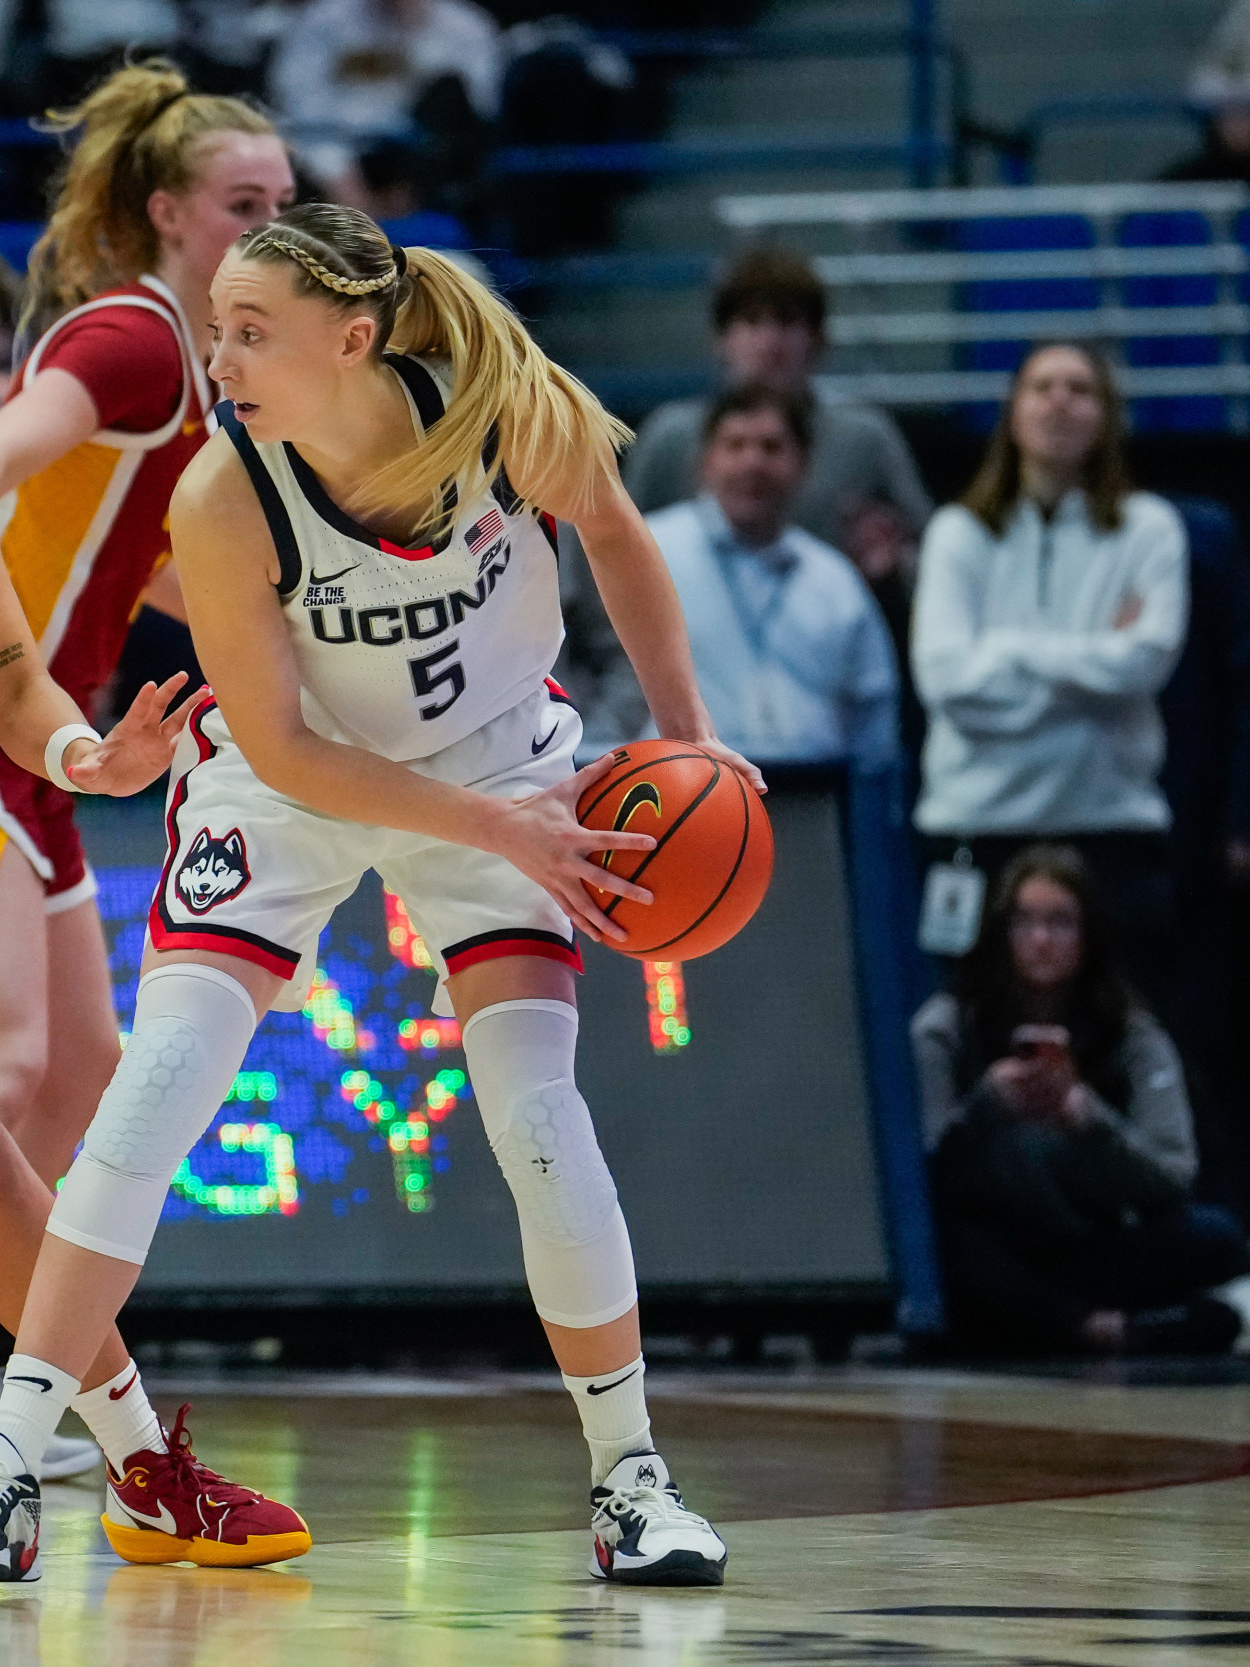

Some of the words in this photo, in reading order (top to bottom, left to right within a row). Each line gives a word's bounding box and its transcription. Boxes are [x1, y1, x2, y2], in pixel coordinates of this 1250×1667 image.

[303, 597, 347, 608] CHANGE
[306, 587, 321, 598] BE
[324, 587, 345, 598] THE
[308, 541, 511, 646] UCONN
[407, 638, 466, 721] 5
